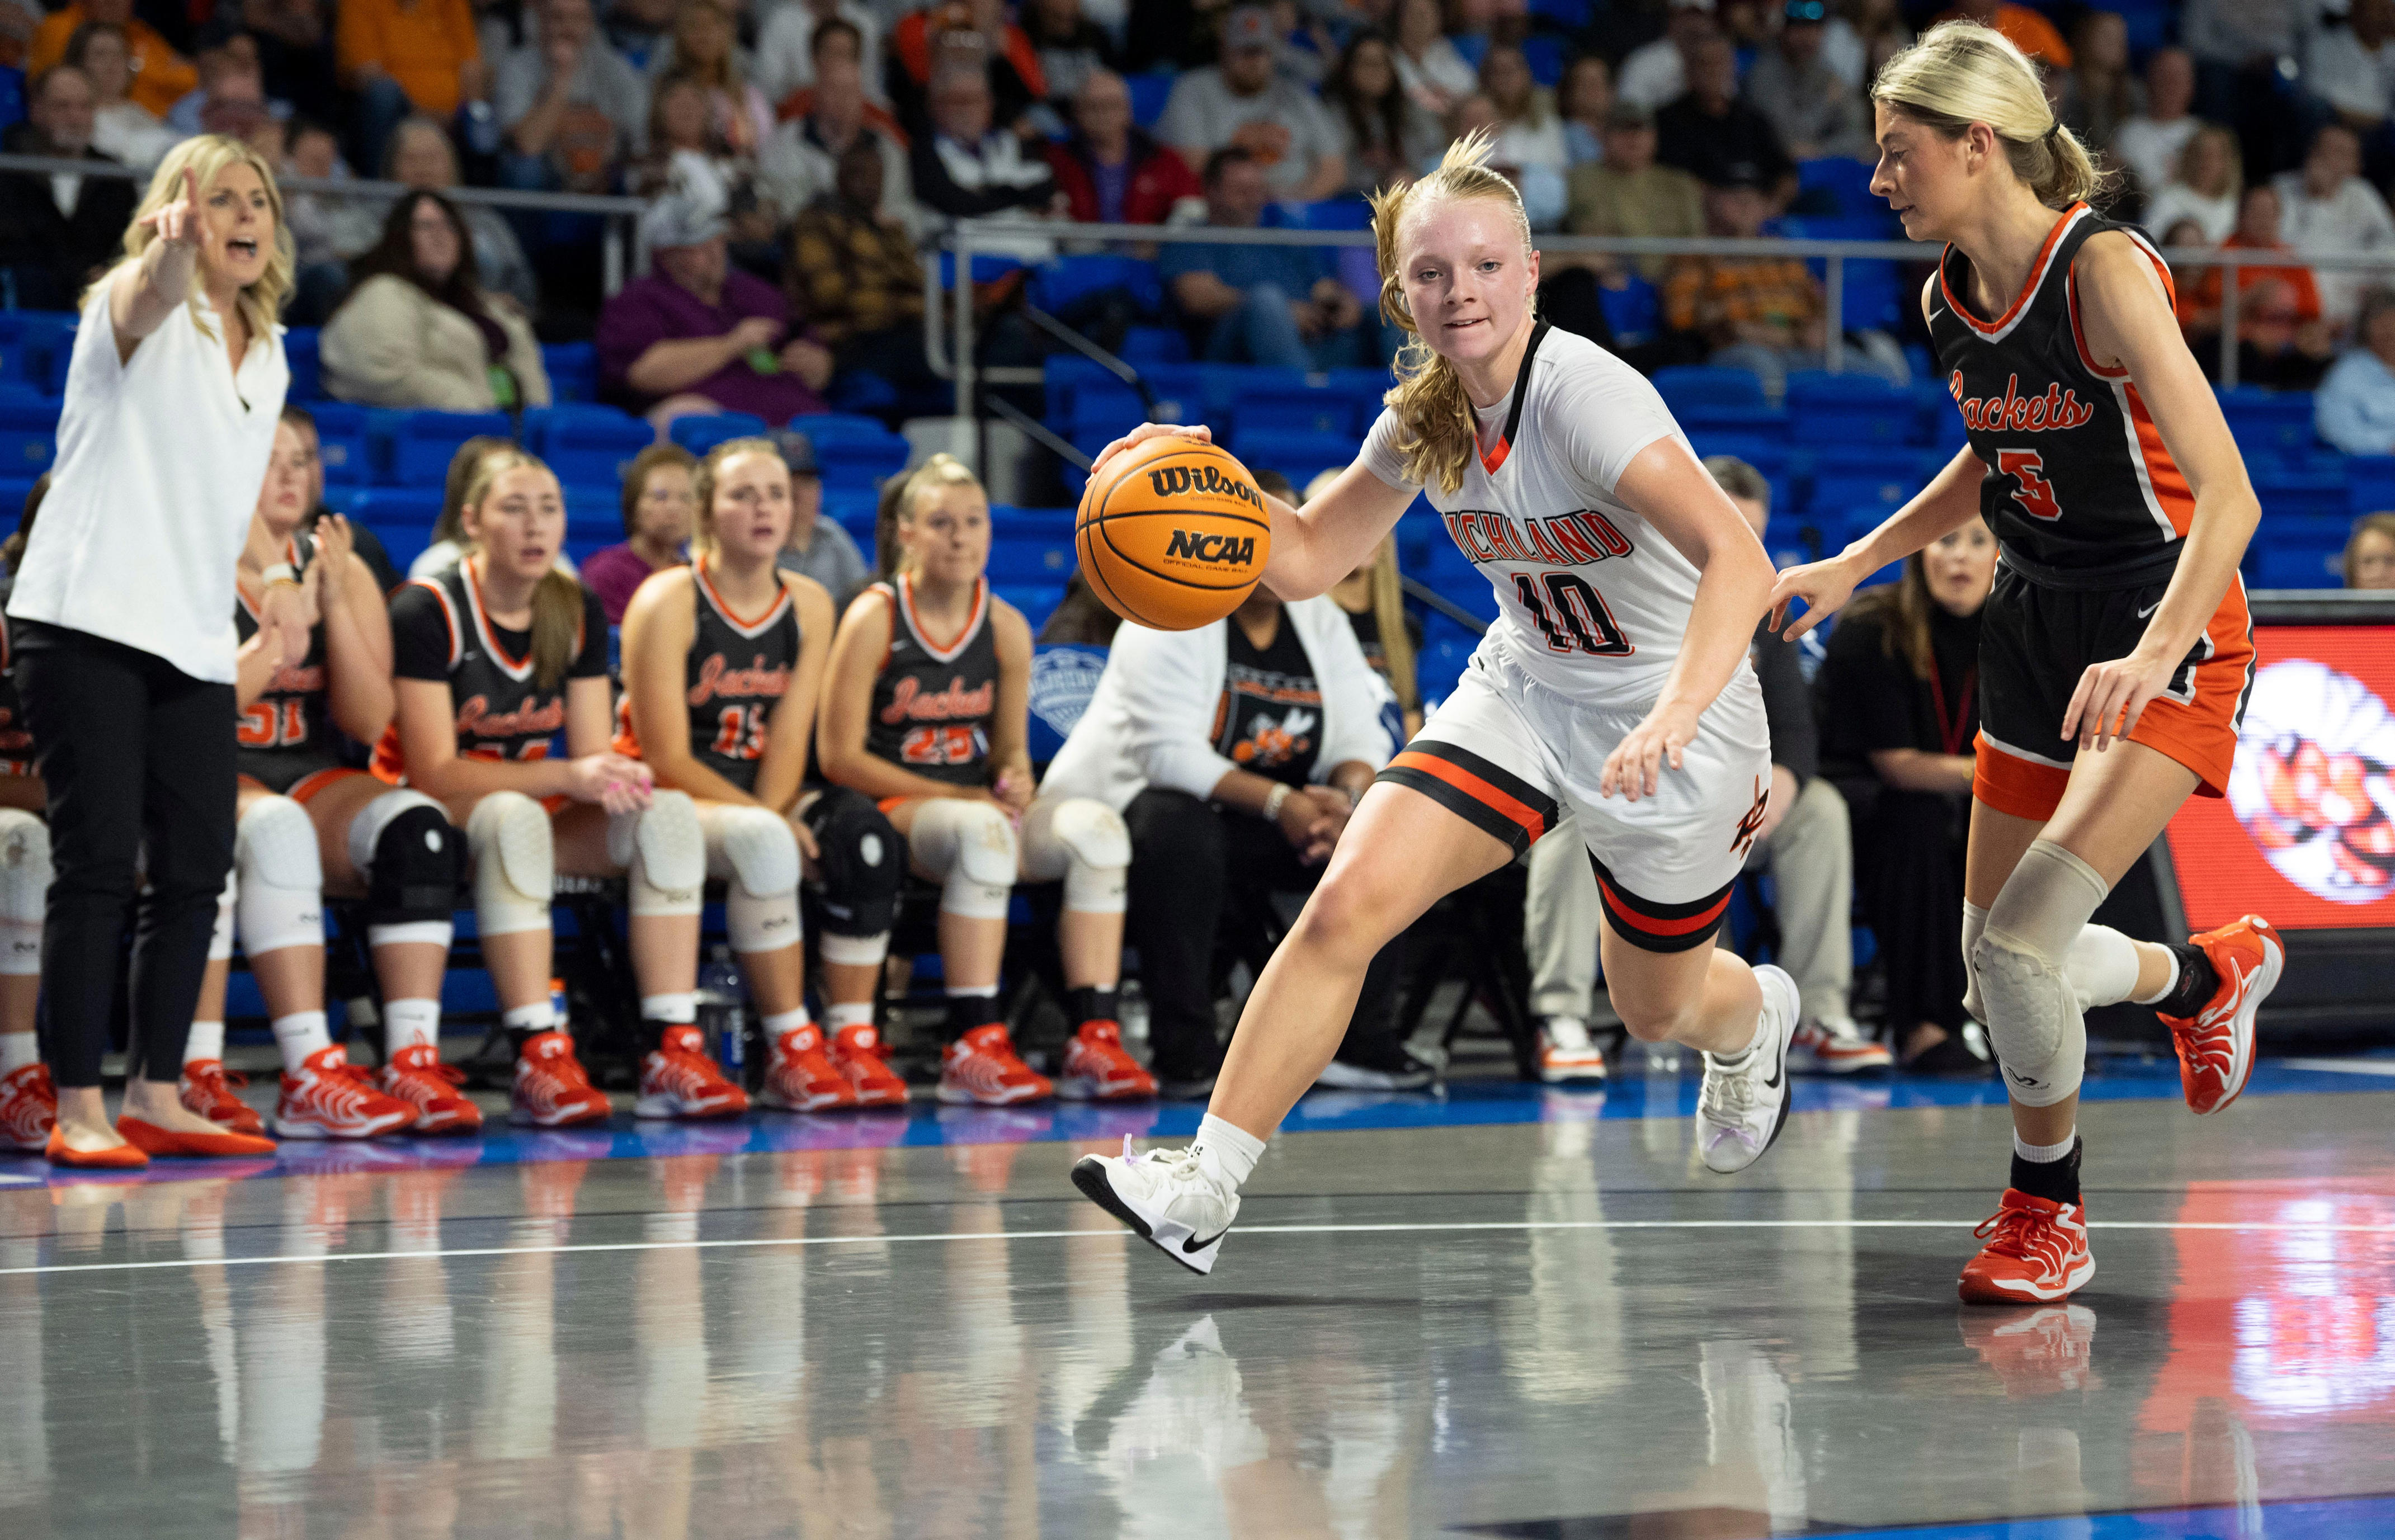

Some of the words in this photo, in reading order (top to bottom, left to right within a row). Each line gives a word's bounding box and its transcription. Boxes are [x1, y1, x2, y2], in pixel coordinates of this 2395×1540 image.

[1148, 466, 1264, 513] Wilson
[1996, 448, 2063, 521] 5
[1165, 528, 1255, 566] NCAA
[1441, 509, 1634, 566] ICHLAND
[1163, 559, 1203, 569] OFFICIAL
[1206, 564, 1229, 572] GAME
[1511, 570, 1635, 657] 10
[900, 725, 975, 764] 25
